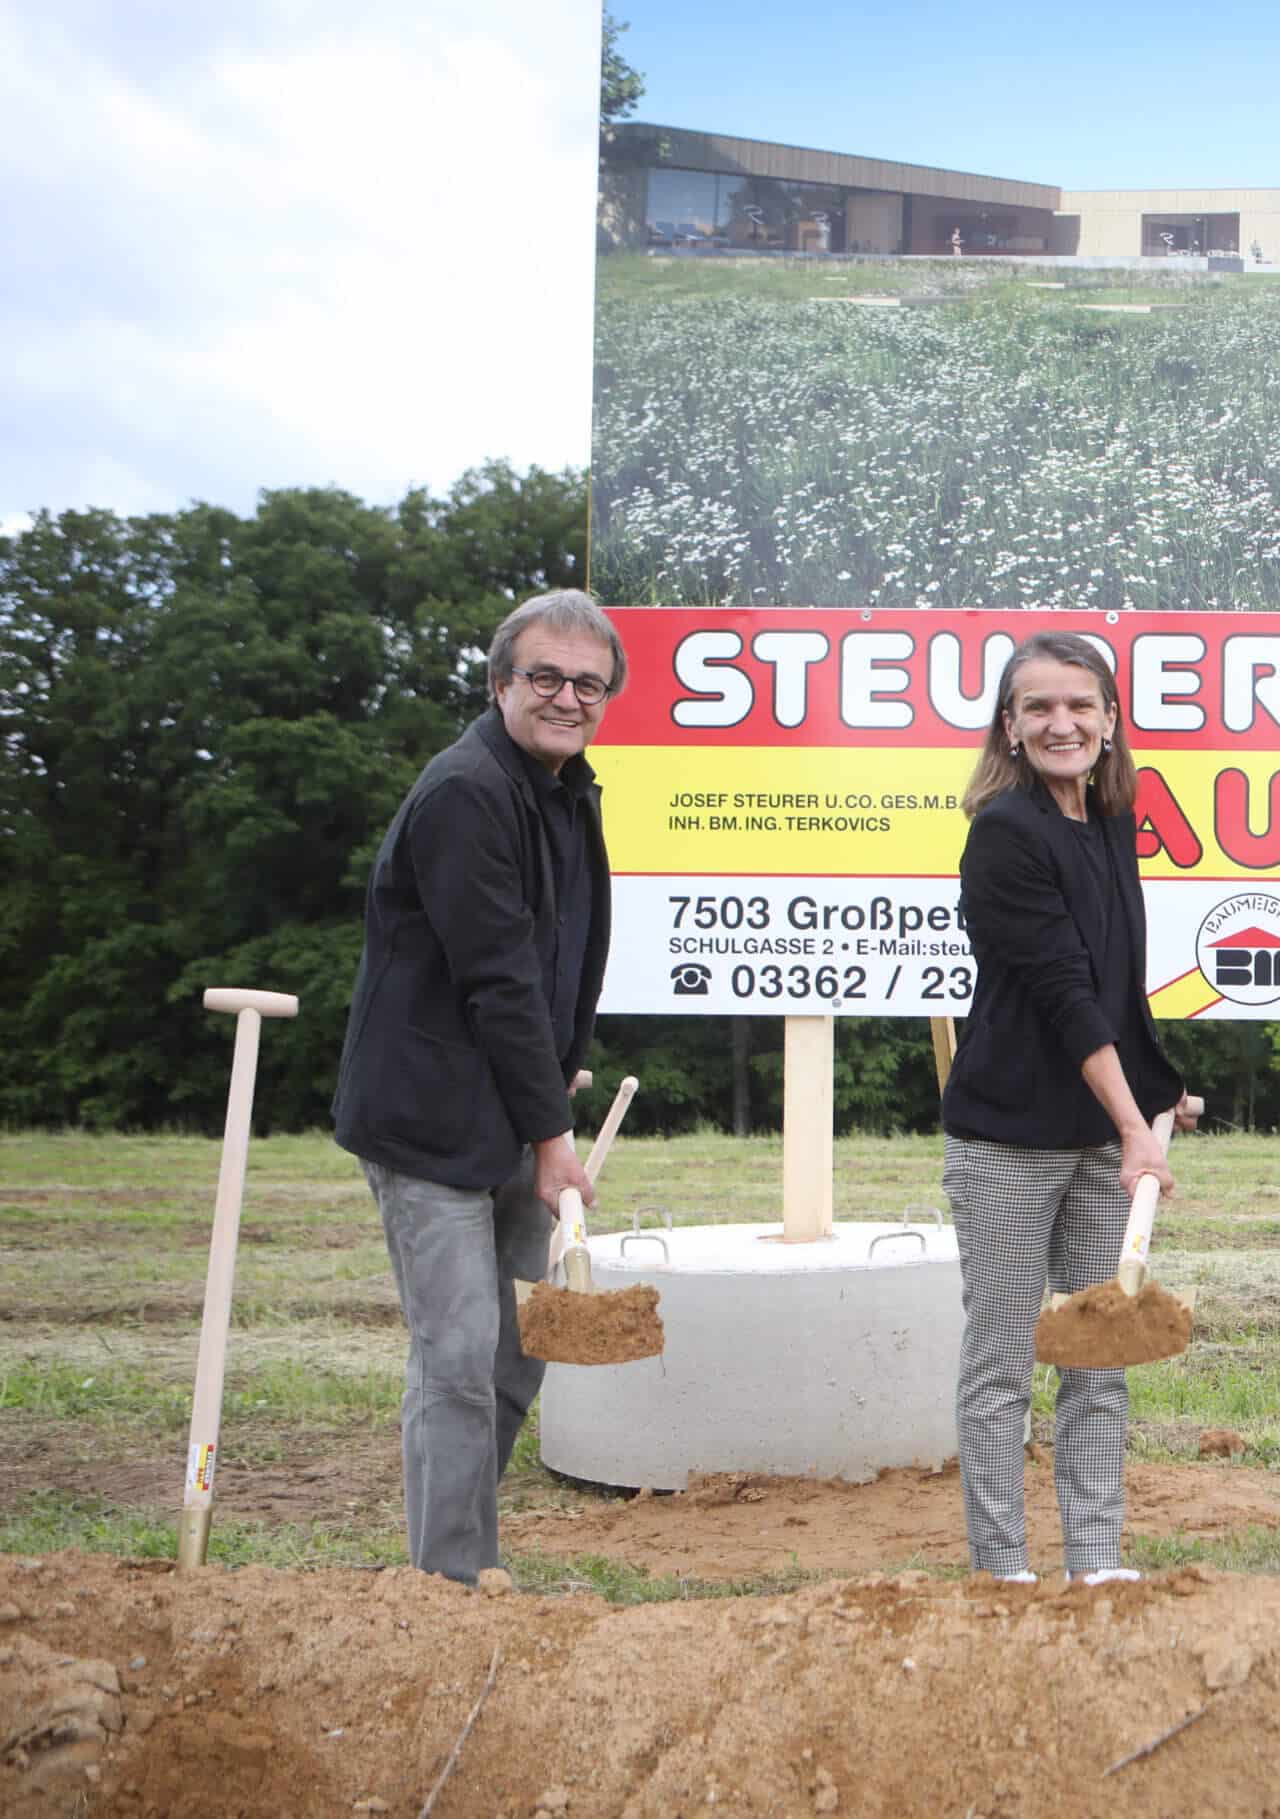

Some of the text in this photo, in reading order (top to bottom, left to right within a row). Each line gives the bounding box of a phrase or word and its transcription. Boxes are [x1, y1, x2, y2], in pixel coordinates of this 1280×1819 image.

[669, 793, 729, 808] JOSEF
[733, 793, 819, 809] STEURER
[784, 816, 891, 832] TERKOVICS
[668, 895, 771, 930] 7503
[669, 937, 816, 955] SCHULGASSE
[822, 938, 834, 955] 2
[731, 964, 974, 1000] 03362 / 23
